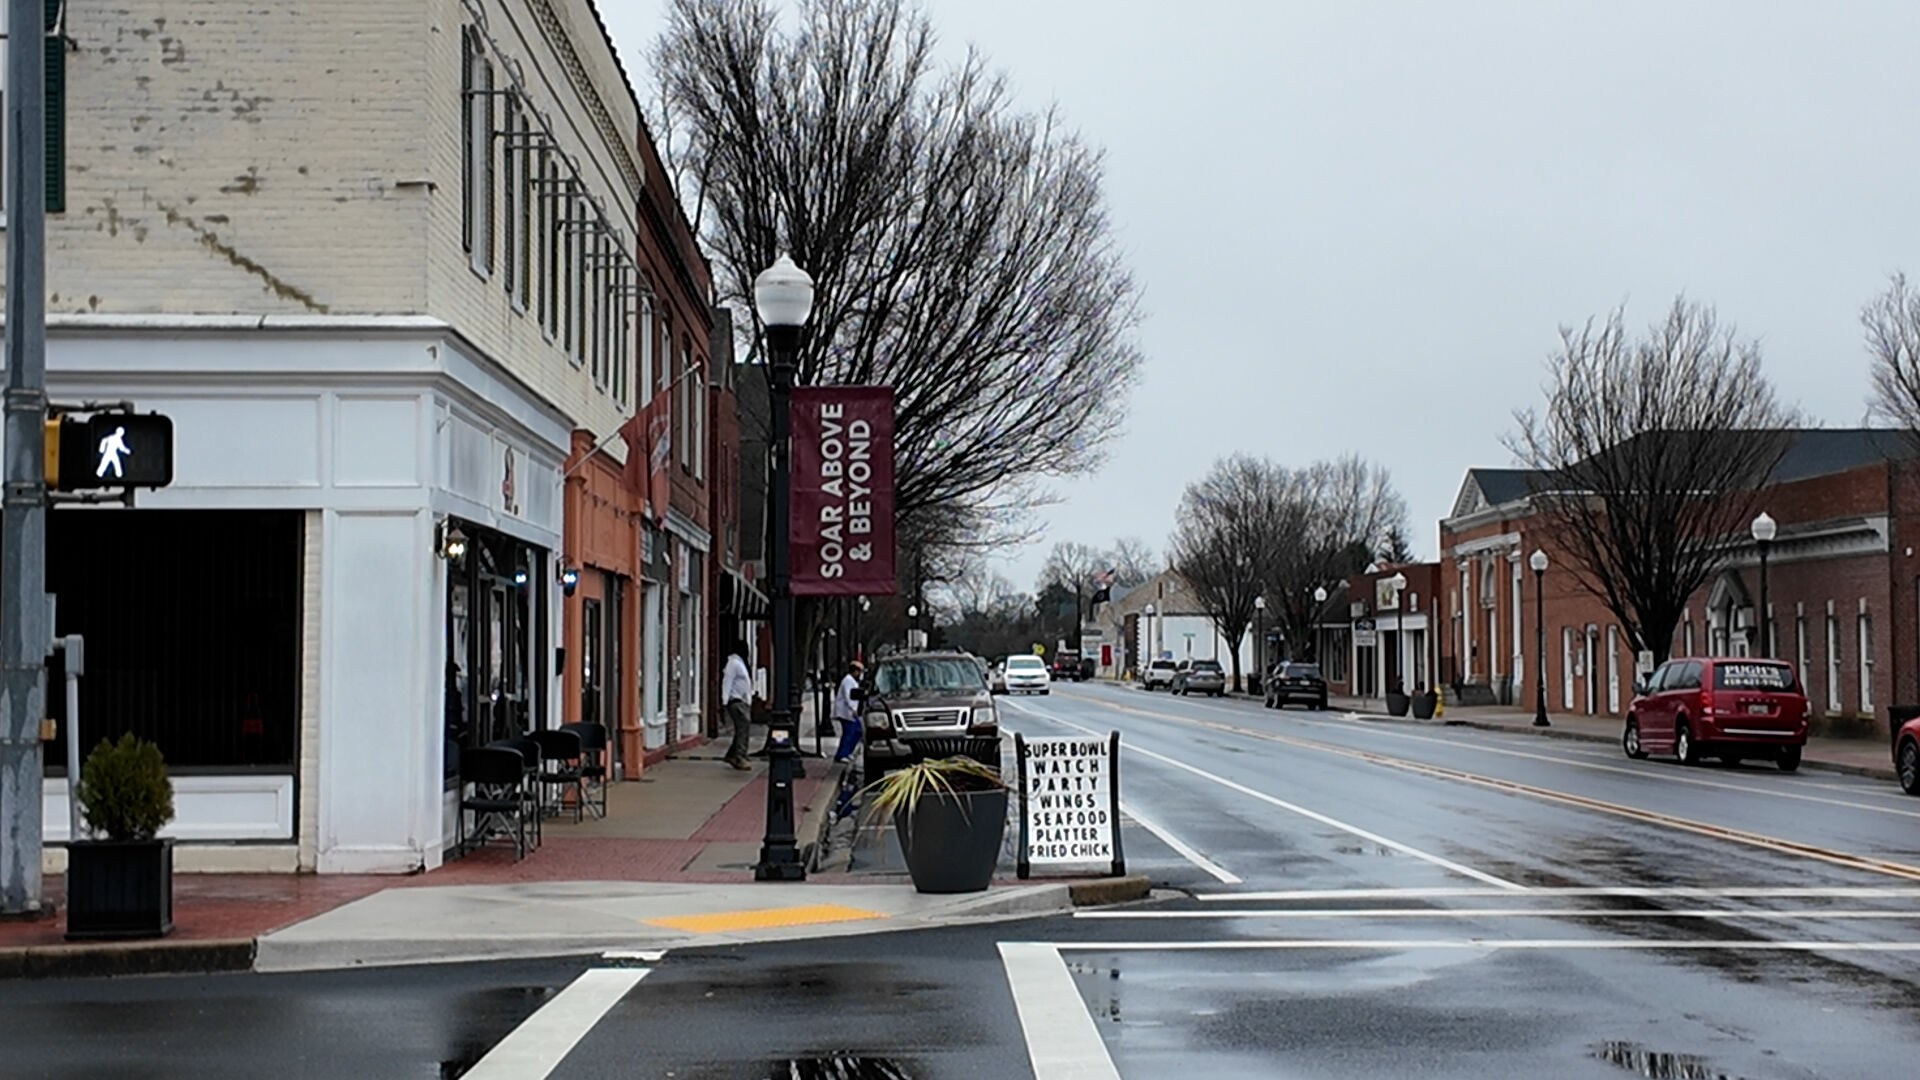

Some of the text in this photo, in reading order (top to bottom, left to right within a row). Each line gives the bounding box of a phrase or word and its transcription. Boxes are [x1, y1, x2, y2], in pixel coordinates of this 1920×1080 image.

[820, 403, 843, 578] SOAR ABOVE
[848, 420, 872, 561] & BEYOND
[1025, 742, 1107, 758] SUPER BOWL
[1034, 759, 1099, 774] WATCH
[1032, 776, 1098, 791] PARTY
[1040, 794, 1096, 808] WINGS
[1033, 810, 1107, 826] SEAFOOD
[1036, 828, 1098, 842] PLATTER
[1029, 843, 1110, 857] FRIED CHICK
